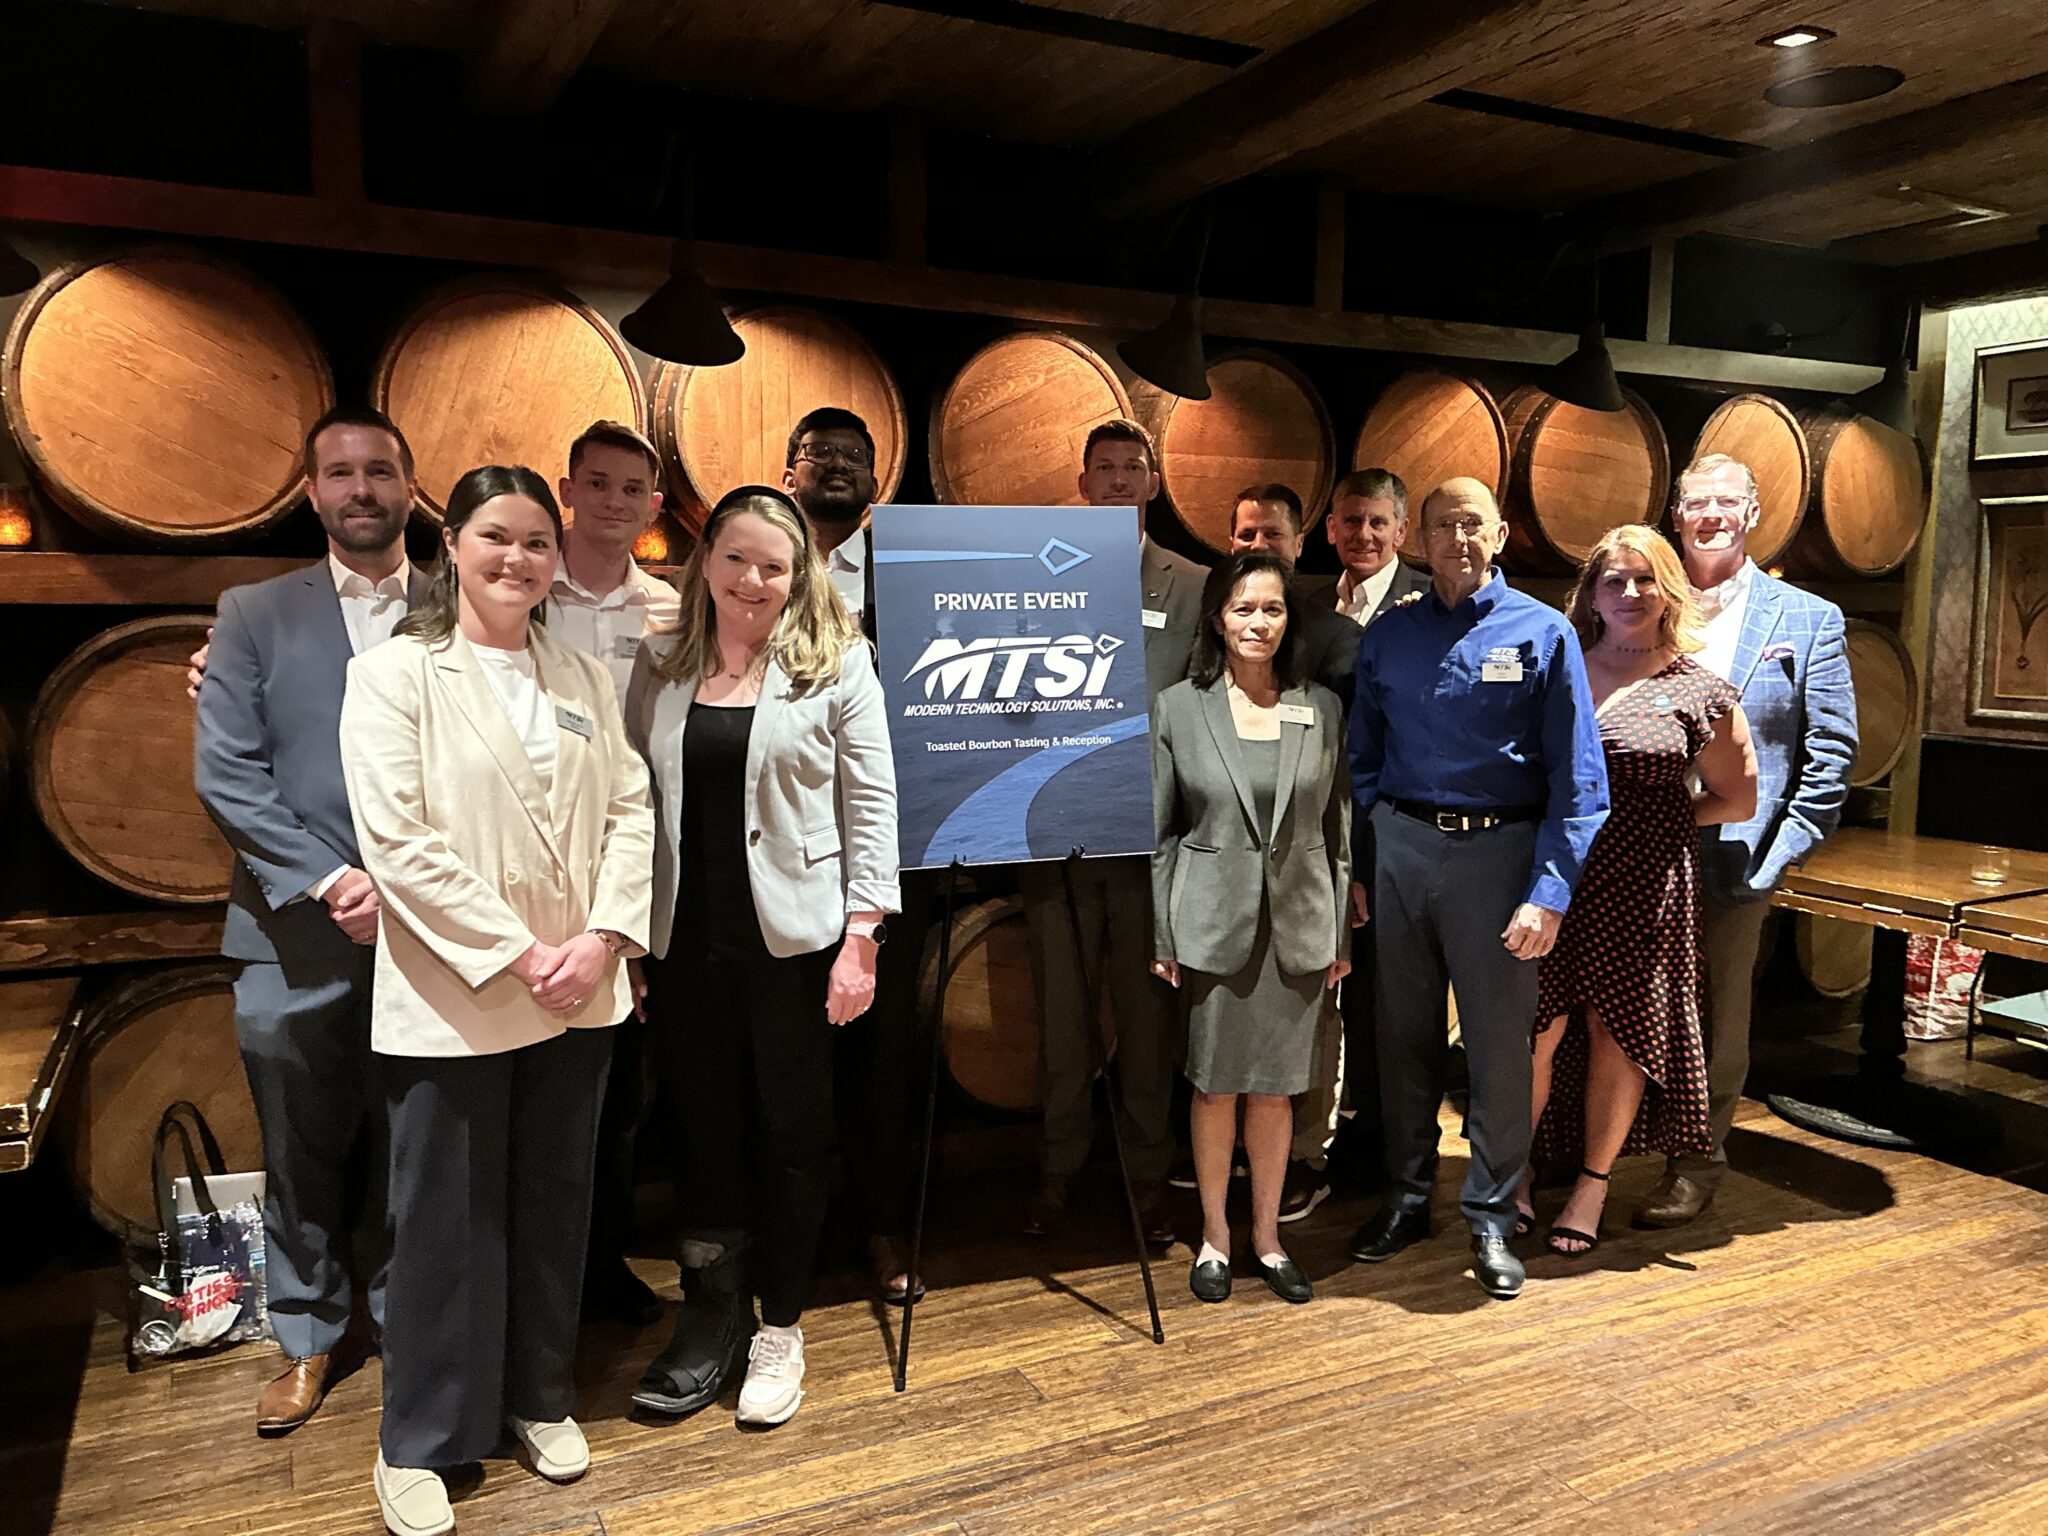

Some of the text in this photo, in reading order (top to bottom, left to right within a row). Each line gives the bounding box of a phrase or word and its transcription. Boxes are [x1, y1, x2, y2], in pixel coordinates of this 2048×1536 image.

[935, 592, 1089, 611] PRIVATE EVENT
[904, 698, 1115, 716] MODERN TECHNOLOGY SOLUTIONS, INC.
[926, 735, 1111, 752] Toasted Bourbon Tasting & Reception
